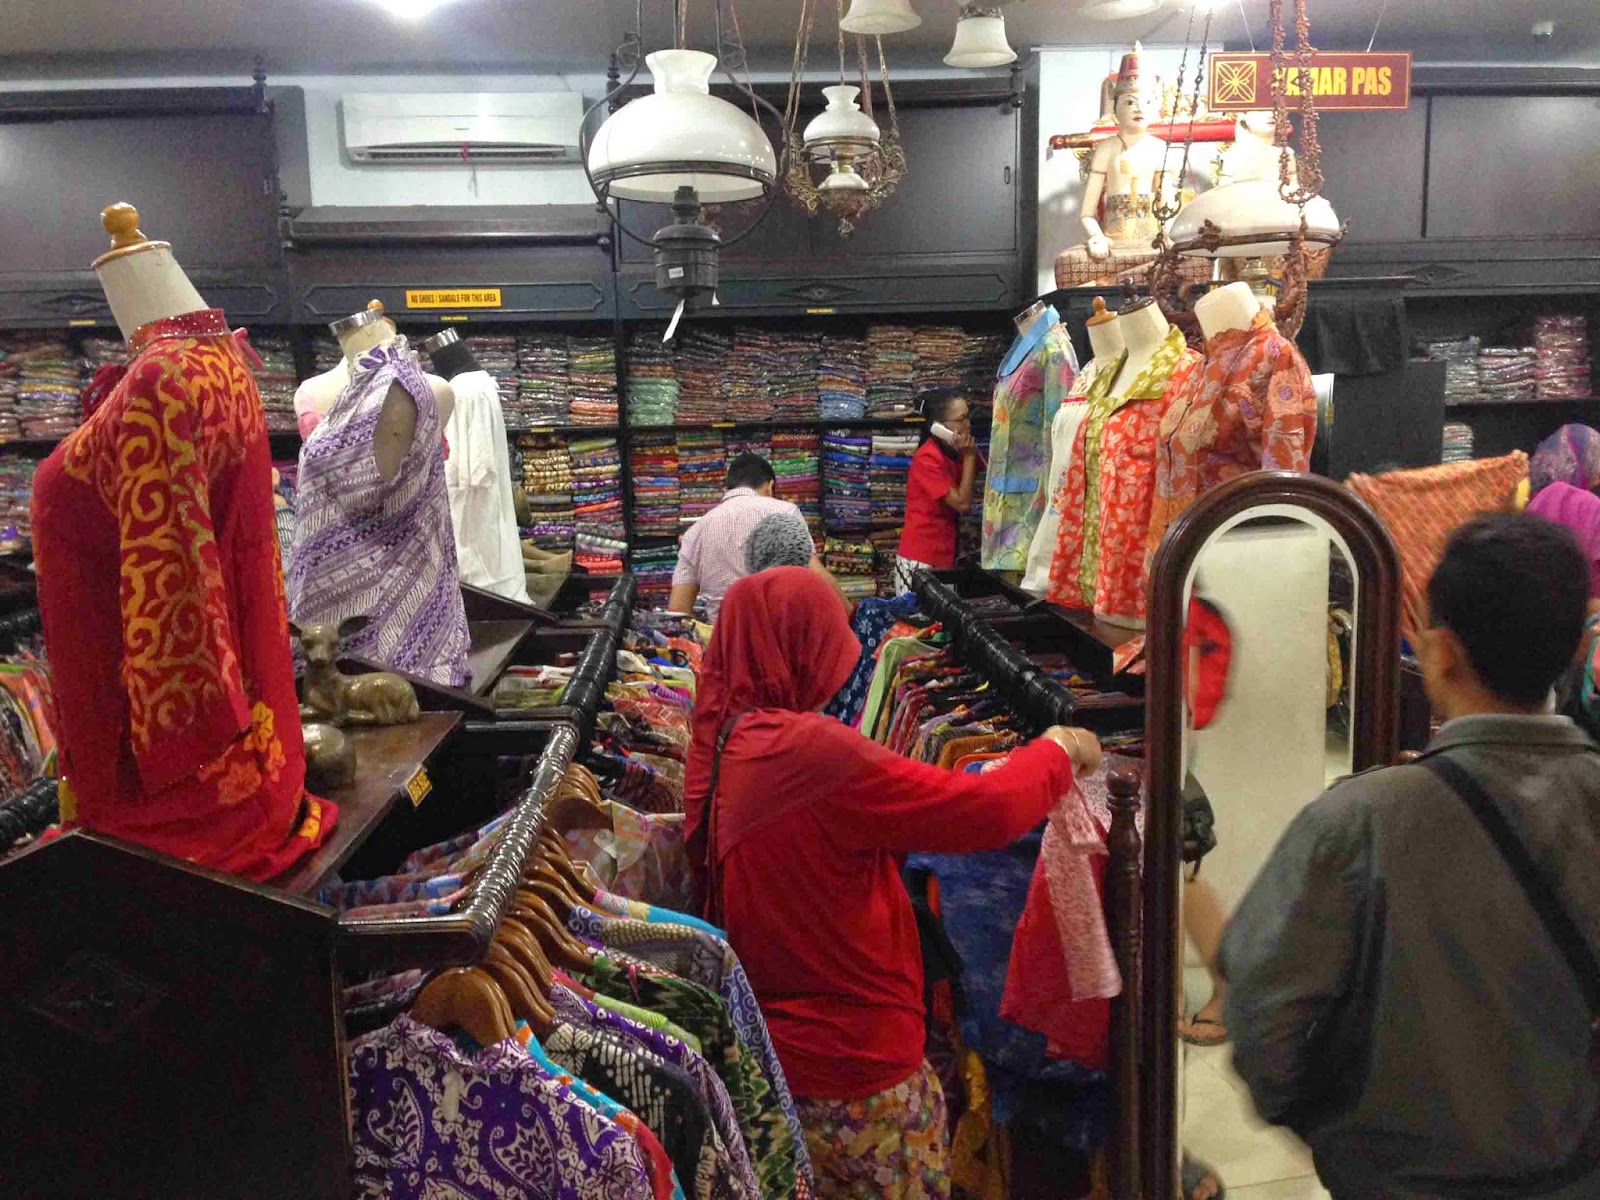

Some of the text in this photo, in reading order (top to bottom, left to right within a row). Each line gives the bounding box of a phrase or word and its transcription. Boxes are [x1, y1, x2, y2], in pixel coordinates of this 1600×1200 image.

[1352, 66, 1392, 96] PAS
[410, 294, 418, 304] NO
[419, 294, 434, 304] SHOES
[439, 294, 460, 303] SANDALS
[461, 293, 470, 303] FOR
[471, 293, 483, 303] THIS
[484, 293, 496, 302] AREA
